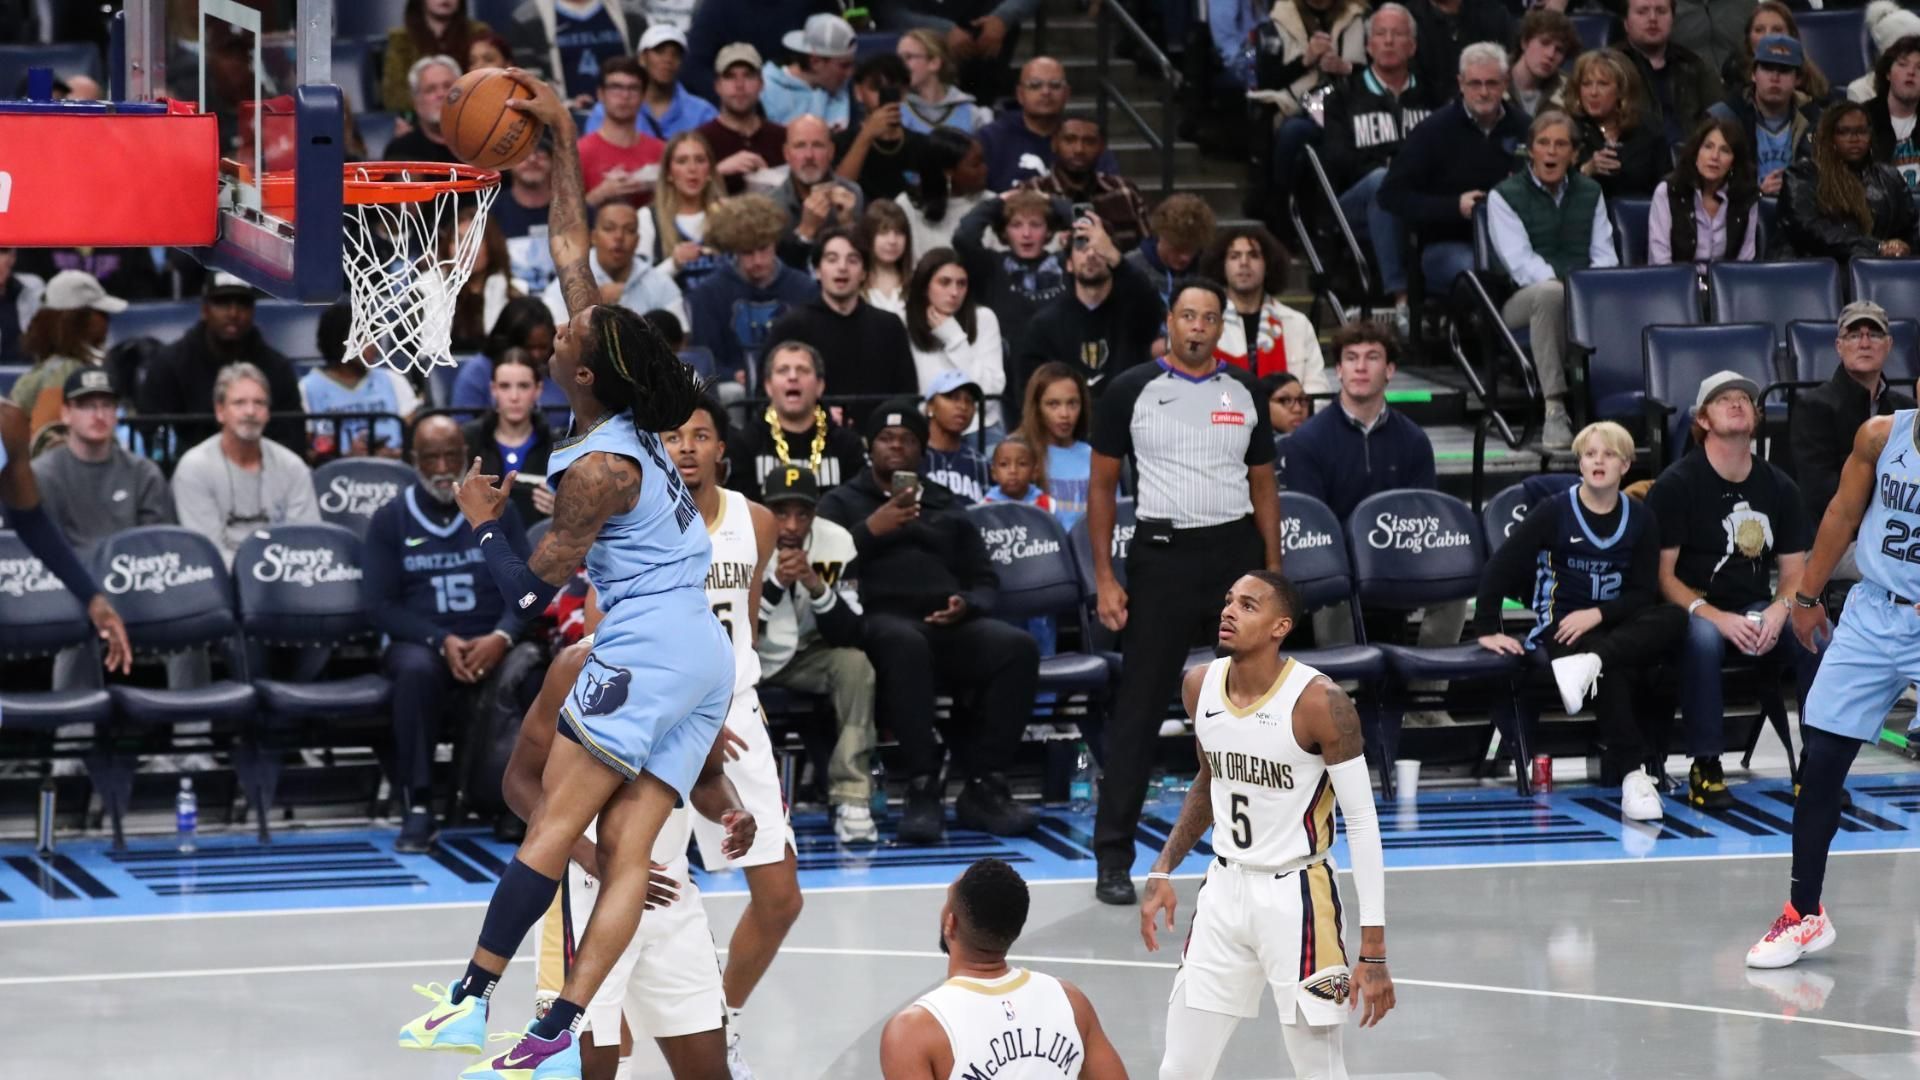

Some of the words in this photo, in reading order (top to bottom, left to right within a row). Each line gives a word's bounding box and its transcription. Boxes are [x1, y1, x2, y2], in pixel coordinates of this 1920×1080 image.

[785, 468, 800, 487] P
[320, 475, 398, 513] Sissy's
[981, 525, 1028, 547] issy's
[1286, 530, 1333, 550] Cabin
[1368, 512, 1440, 549] Sissy's
[1394, 533, 1423, 553] Log
[1424, 530, 1471, 548] Cabin
[252, 543, 334, 582] Sissy's
[404, 547, 485, 571] GRIZZLIE
[990, 544, 1012, 564] og
[1012, 539, 1060, 558] Cabin
[104, 552, 180, 594] Sissy's
[704, 562, 753, 590] RLEANS
[1589, 572, 1622, 600] 12
[430, 573, 477, 613] 15
[1226, 751, 1294, 790] ORLEANS
[1231, 792, 1252, 849] 5
[961, 1027, 1080, 1080] McCOLLUM
